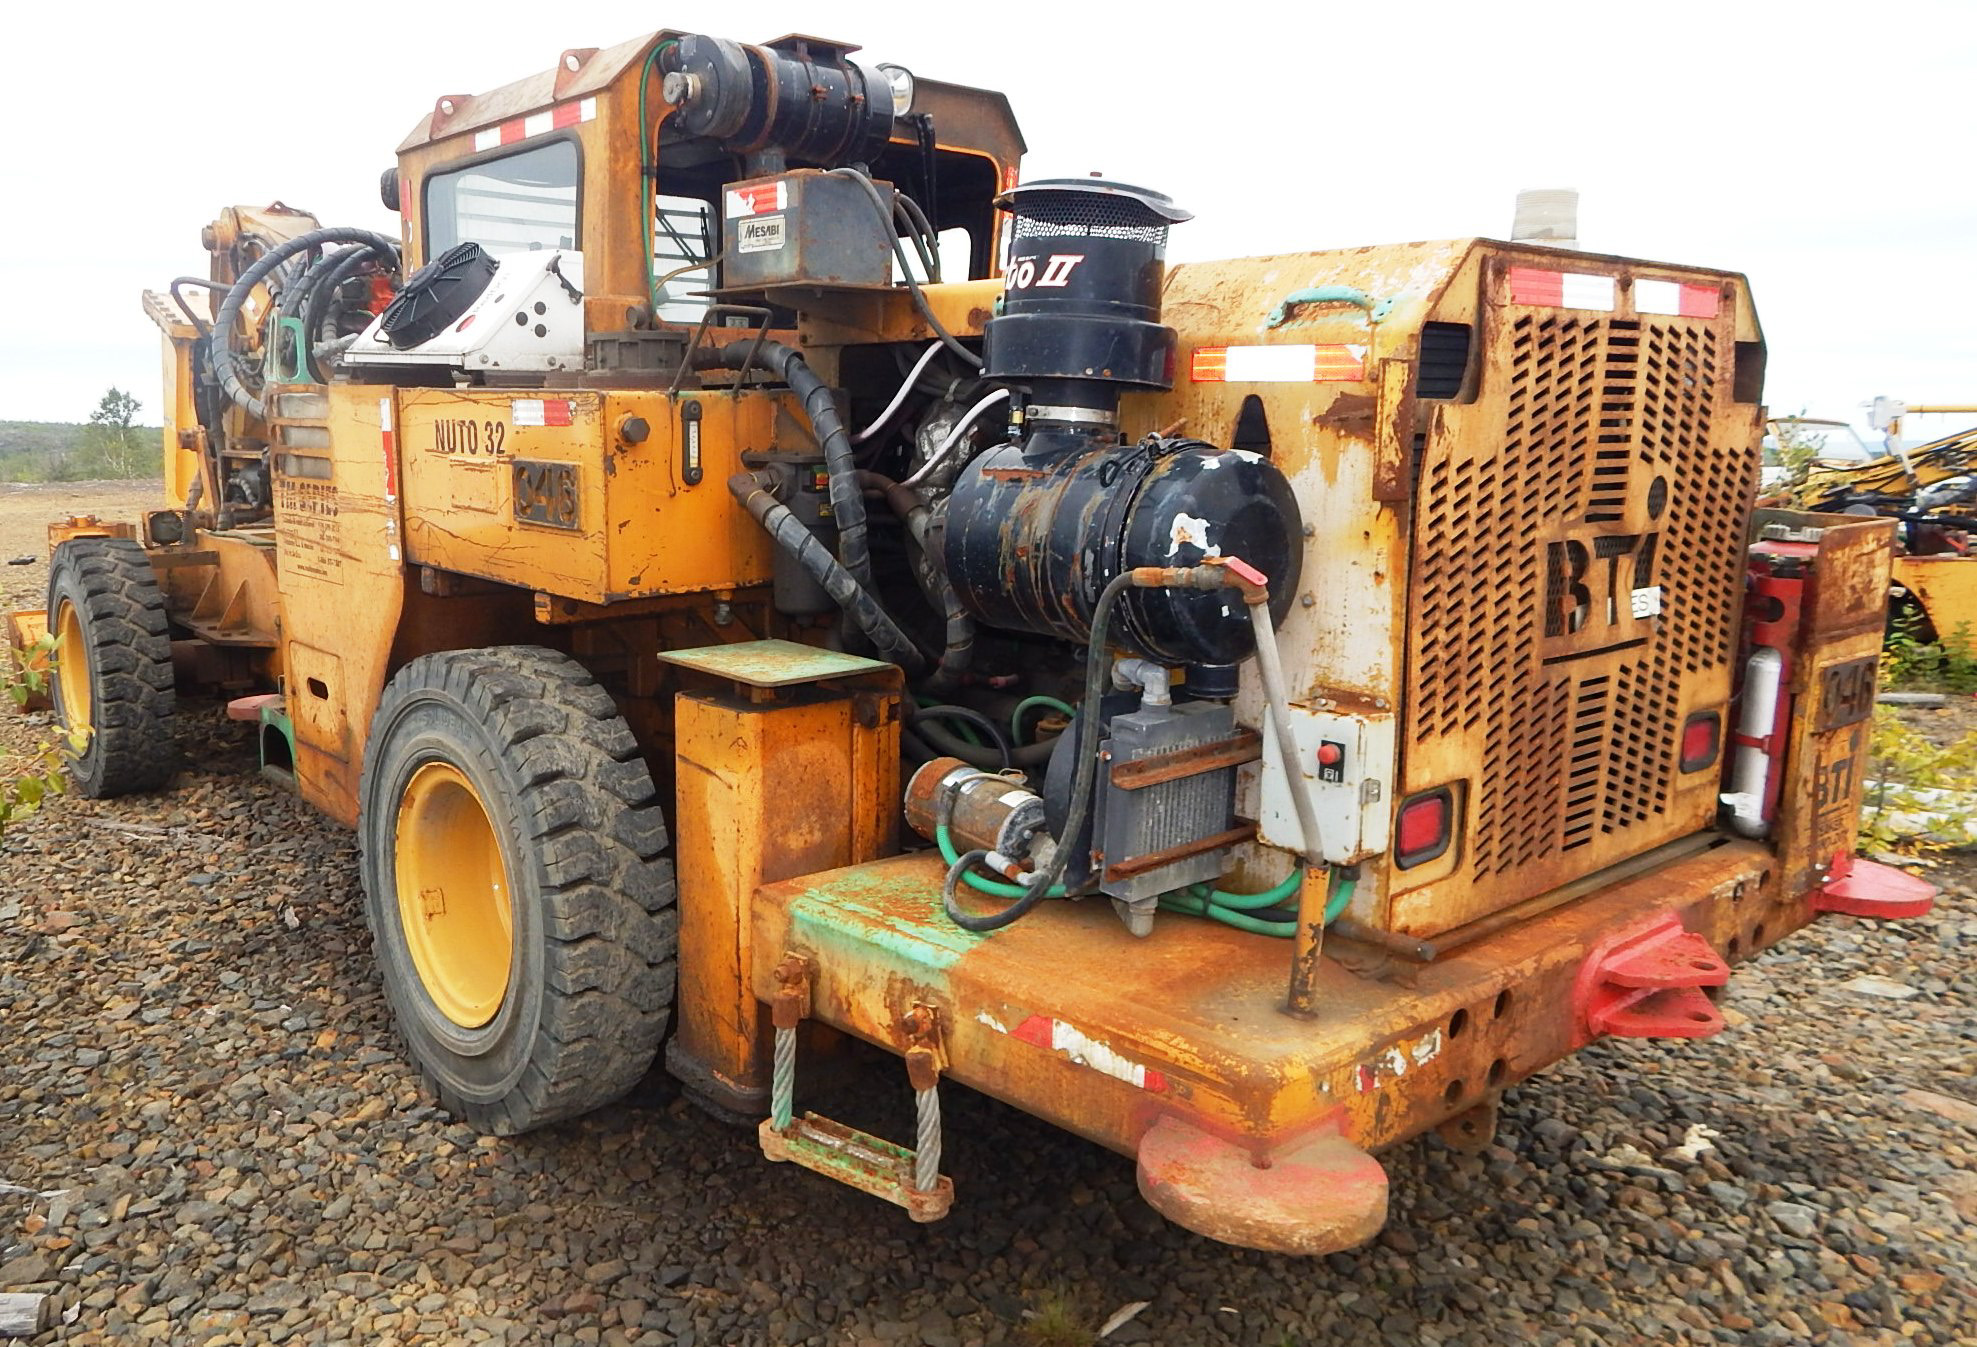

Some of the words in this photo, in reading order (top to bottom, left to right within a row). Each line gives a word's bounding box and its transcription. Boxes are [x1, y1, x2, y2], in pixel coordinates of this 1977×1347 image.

[744, 224, 780, 239] MESABI
[1035, 254, 1085, 287] II
[434, 419, 478, 454] NUTO
[484, 421, 506, 454] 32
